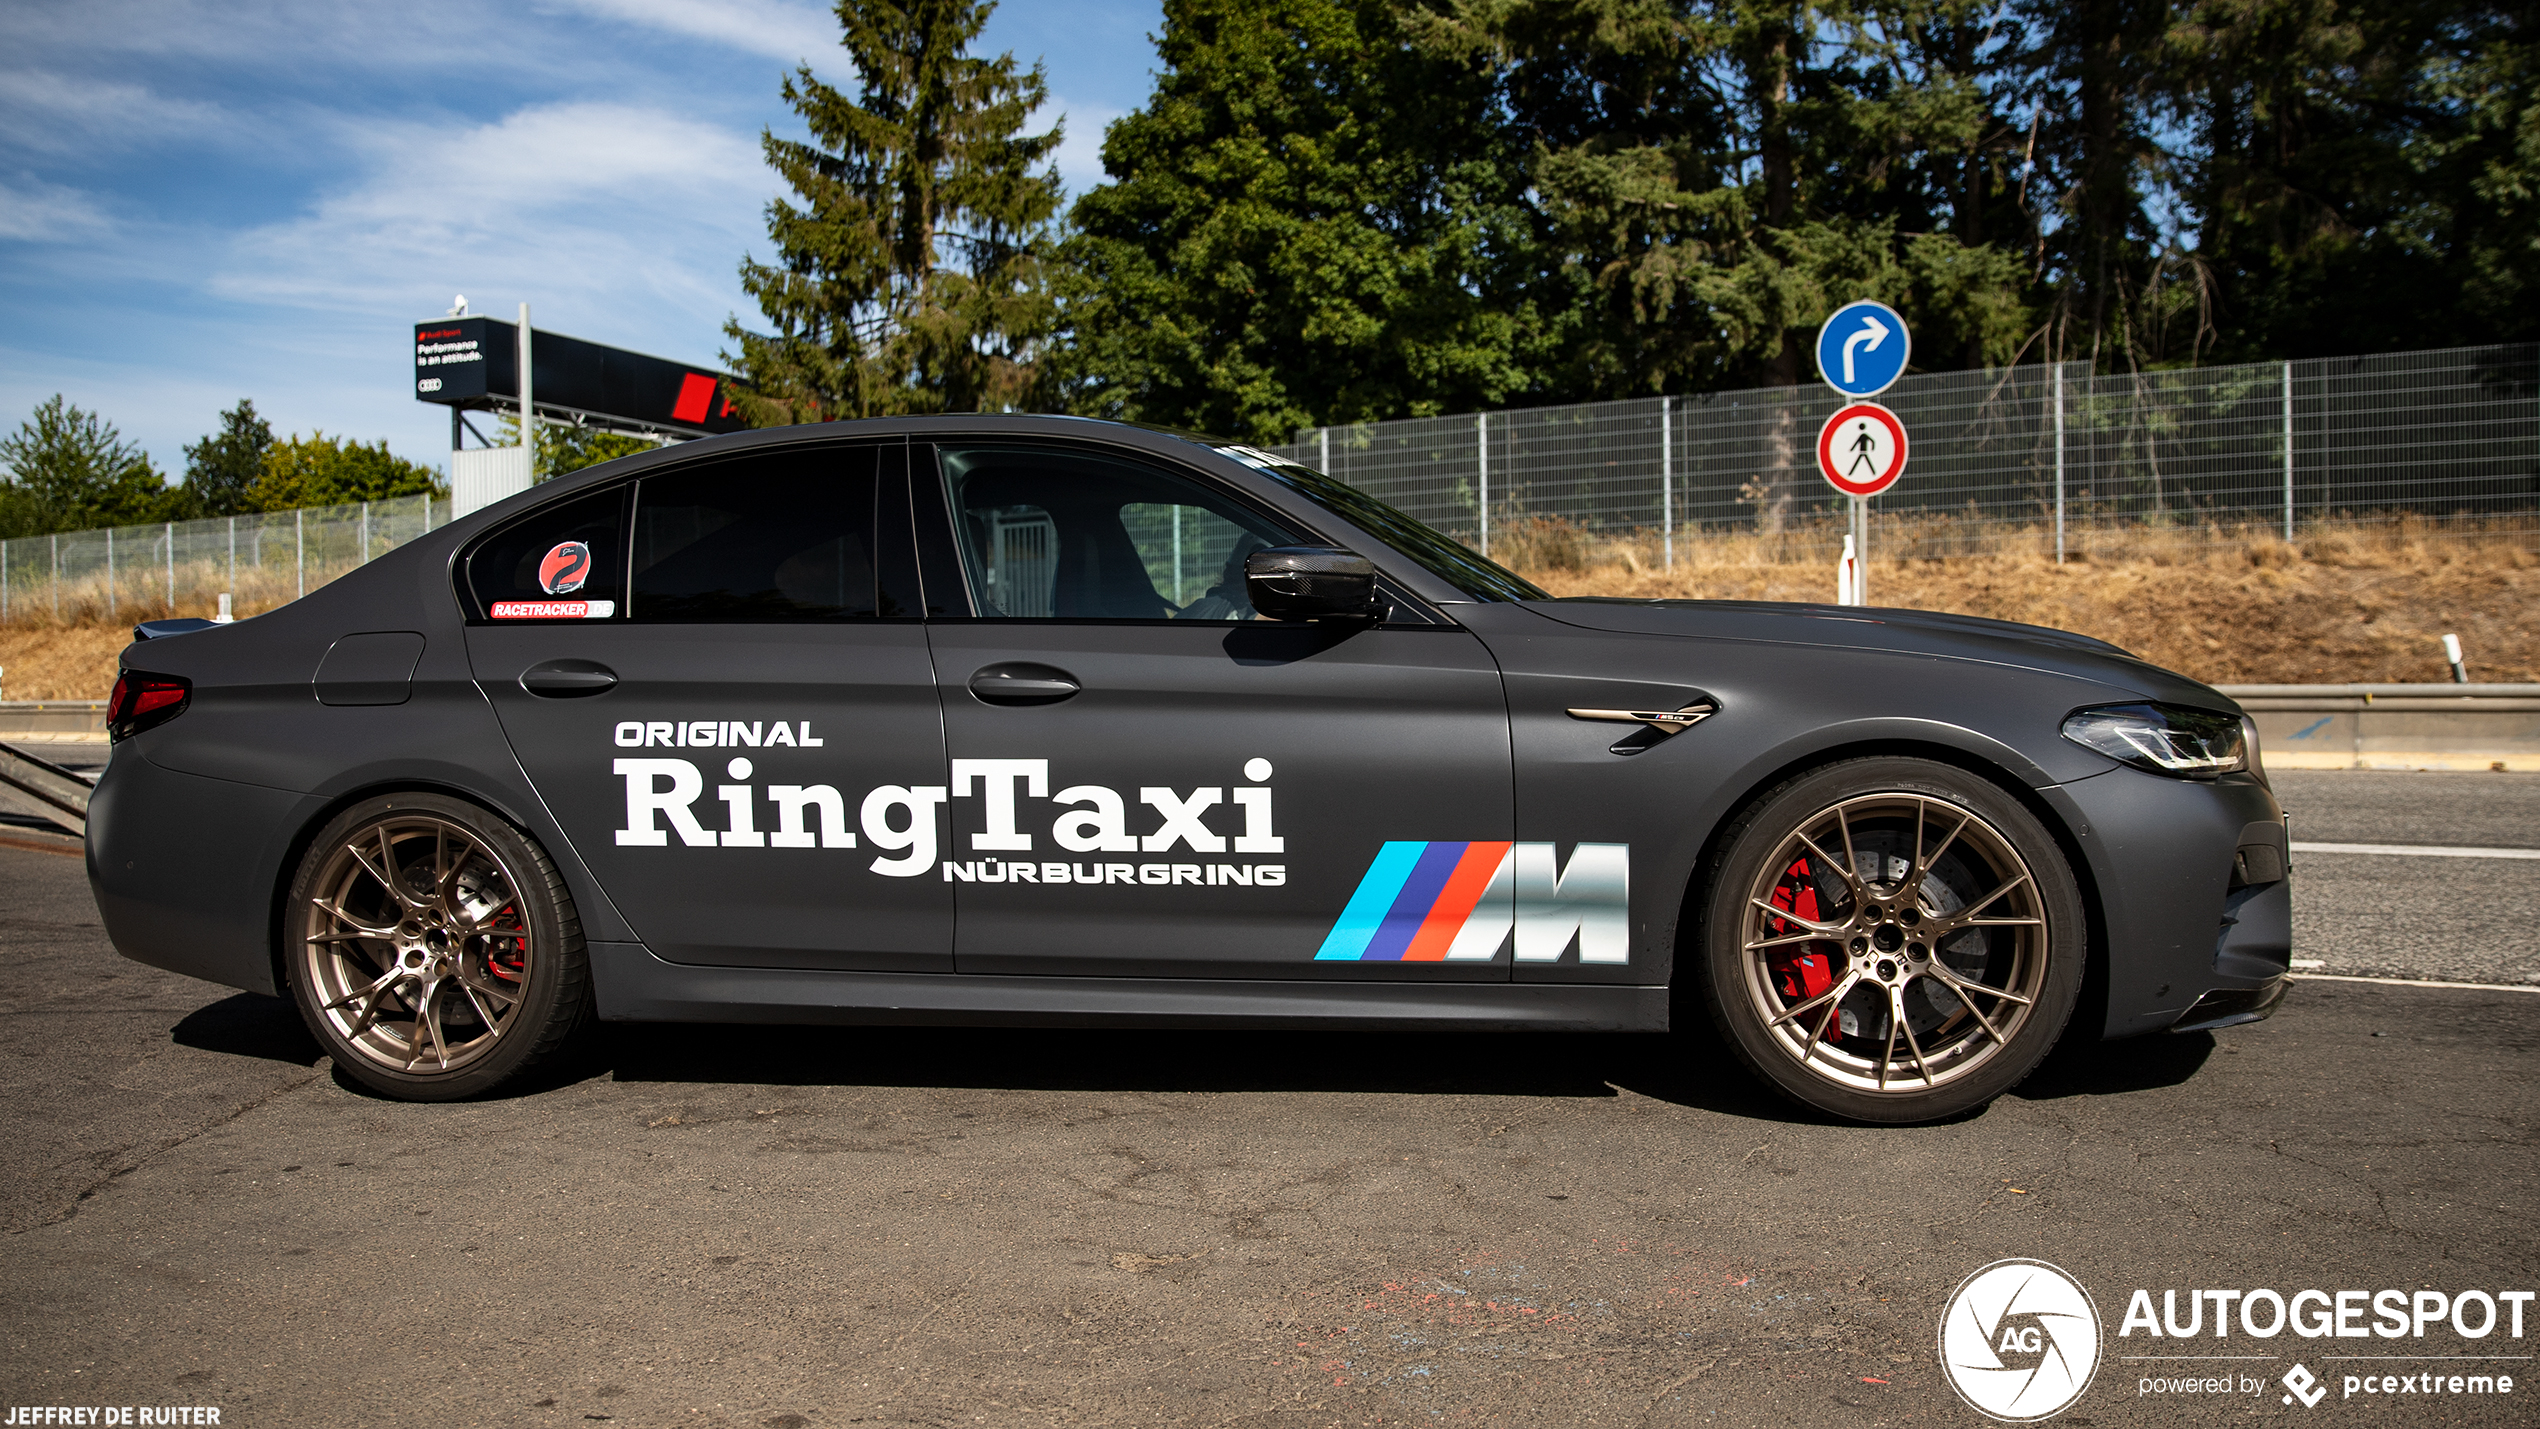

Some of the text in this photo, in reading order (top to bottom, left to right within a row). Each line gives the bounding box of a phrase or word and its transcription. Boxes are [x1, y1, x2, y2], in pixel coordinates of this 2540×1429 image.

[417, 341, 478, 355] Performance
[417, 356, 427, 366] is
[428, 356, 440, 366] an
[614, 721, 824, 748] ORIGINAL
[942, 857, 1287, 887] NÜRBURGRING
[1443, 840, 1630, 966] M
